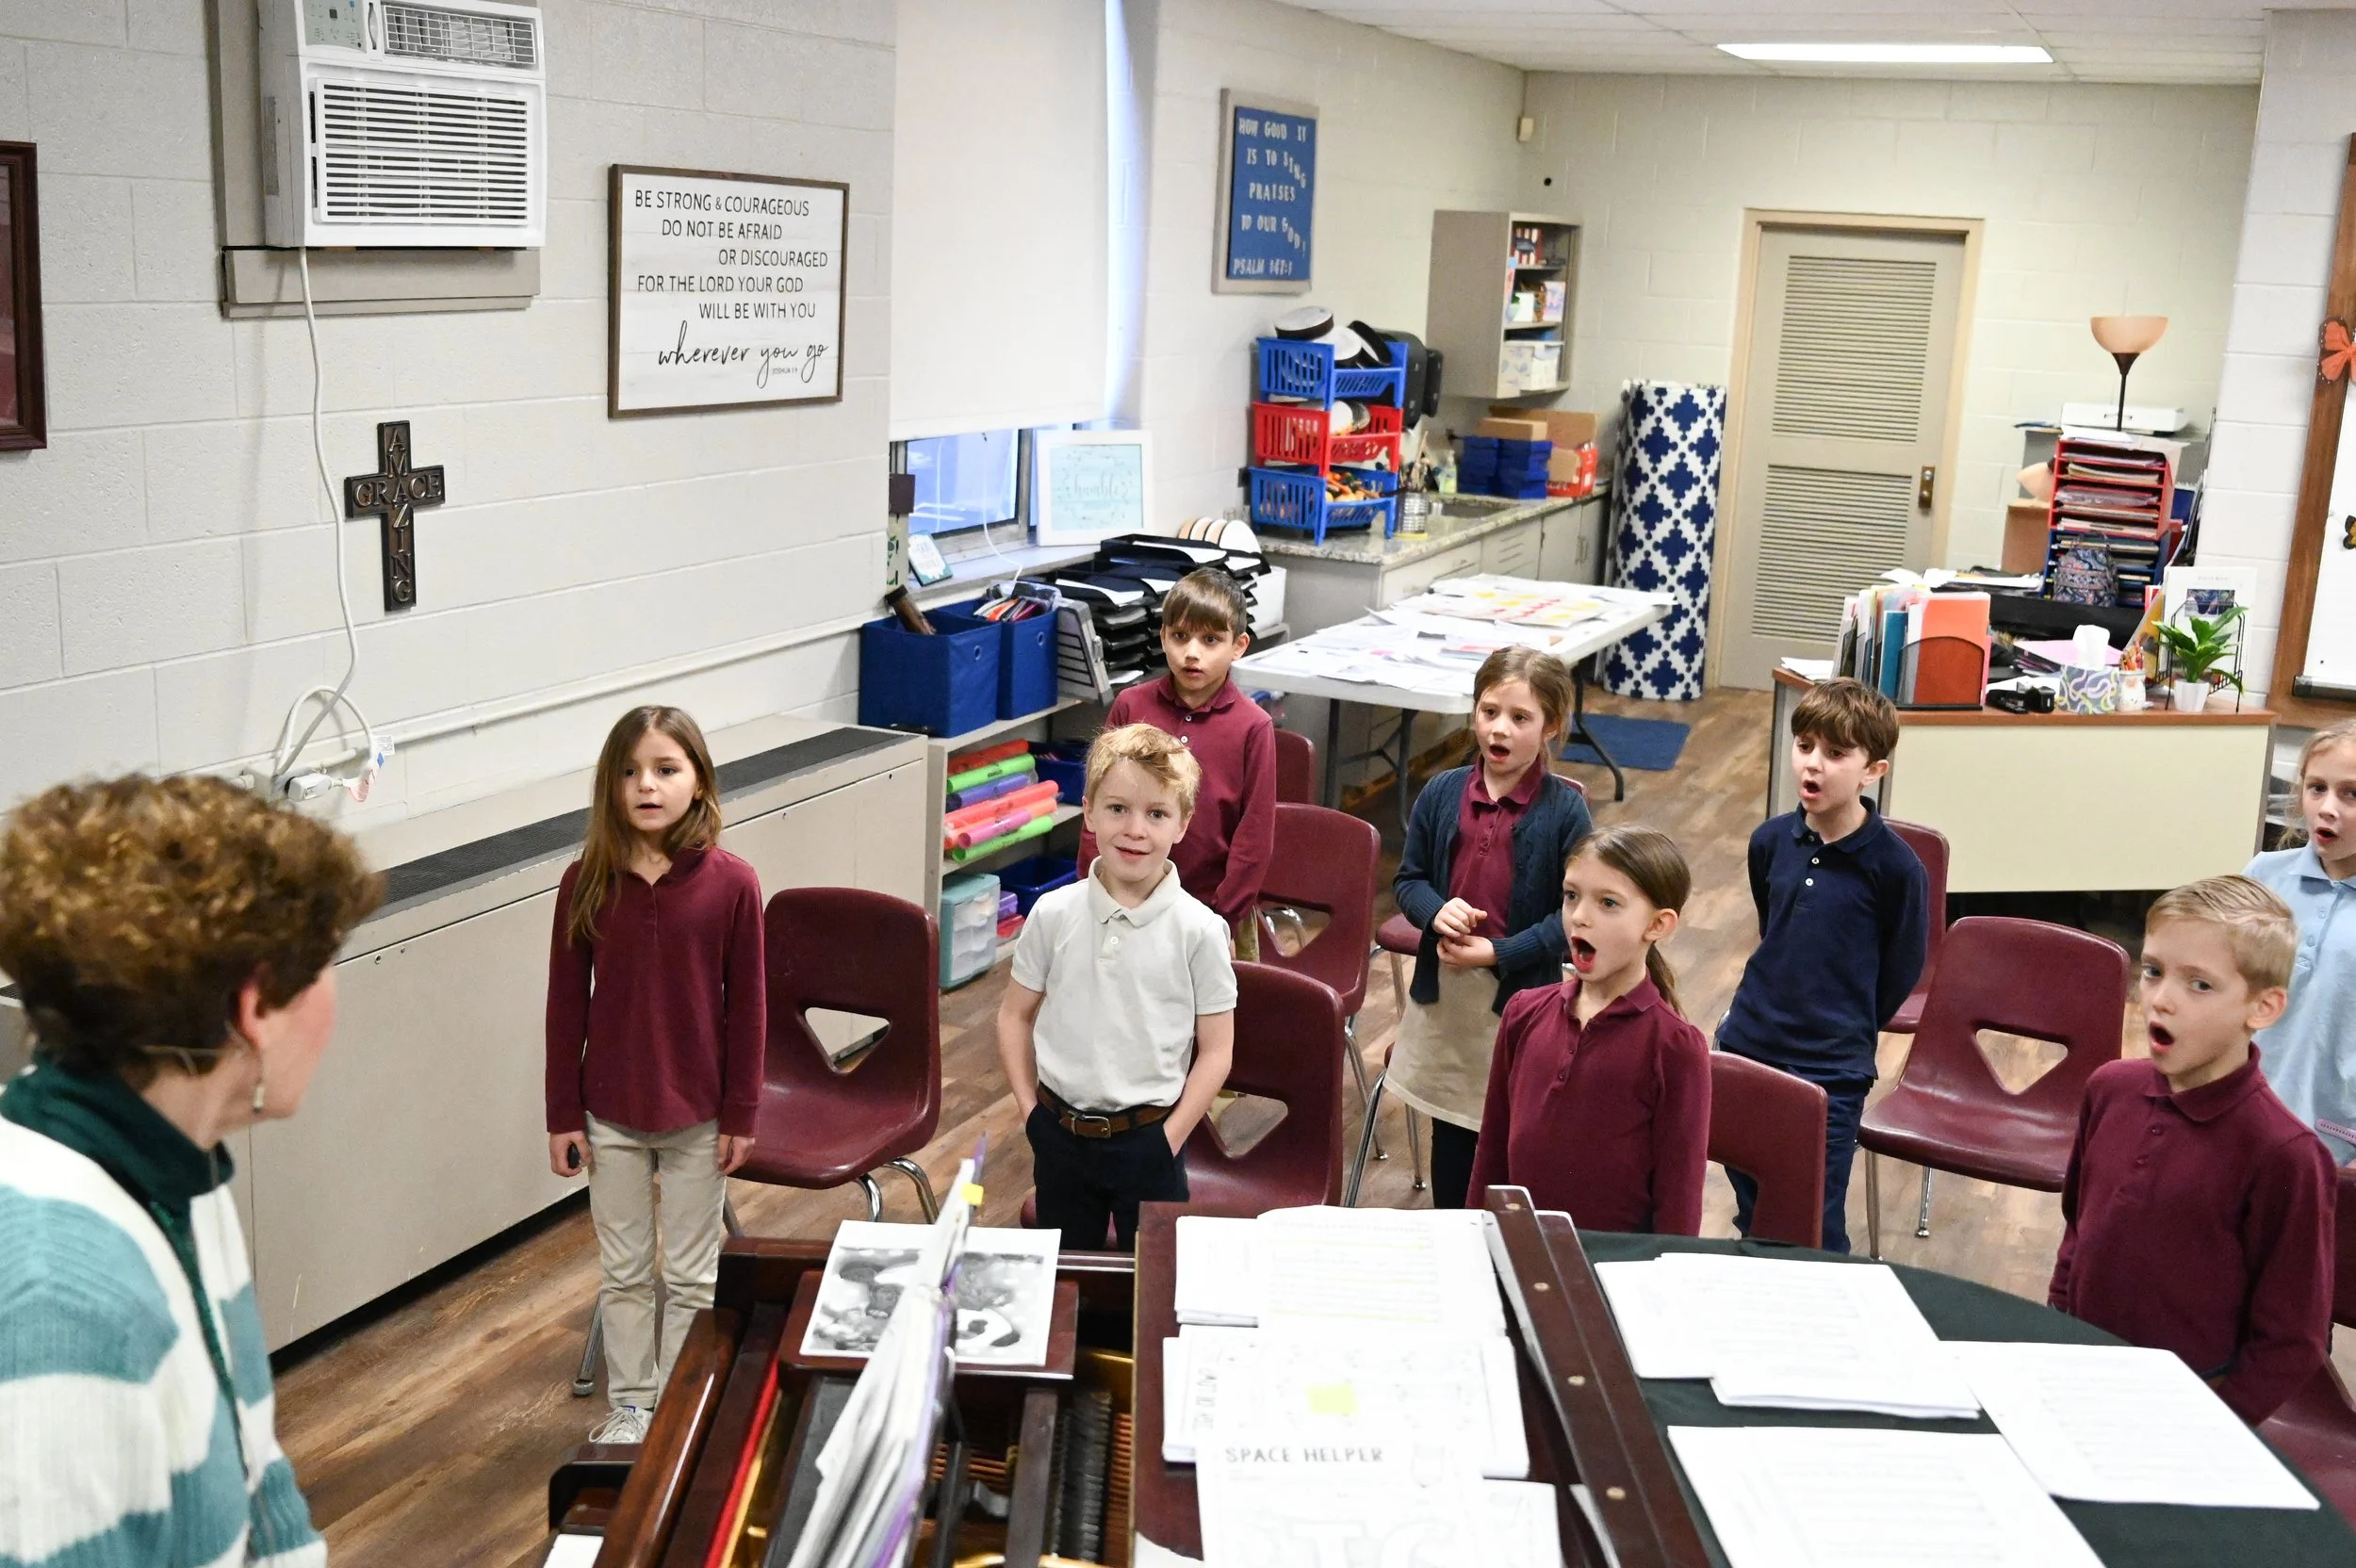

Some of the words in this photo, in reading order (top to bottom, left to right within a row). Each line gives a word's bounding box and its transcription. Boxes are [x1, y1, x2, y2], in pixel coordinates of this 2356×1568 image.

[1238, 118, 1258, 137] HOW
[1264, 121, 1287, 139] GOOD
[1298, 124, 1306, 142] IT
[1247, 148, 1257, 165] IS
[1265, 149, 1277, 166] TO
[1284, 151, 1306, 188] SING
[635, 189, 652, 208] BE
[657, 191, 712, 211] STRONG
[715, 197, 722, 211] &
[725, 195, 810, 216] COURAGEOUS
[1250, 182, 1295, 202] PRAISES
[662, 219, 682, 237] DO
[687, 220, 713, 237] NOT
[718, 222, 734, 238] BE
[738, 222, 782, 240] AFRAID
[1241, 214, 1252, 232] TO
[1257, 215, 1277, 233] OUR
[1282, 217, 1306, 258] GOD!
[718, 249, 736, 265] OR
[742, 250, 828, 268] DISCOURAGED
[1234, 257, 1265, 275] PSALM
[638, 275, 664, 292] FOR
[669, 275, 695, 292] THE
[699, 276, 734, 292] LORD
[738, 276, 772, 292] YOUR
[777, 277, 803, 293] GOD
[699, 302, 729, 318] WILL
[734, 302, 749, 318] BE
[754, 302, 786, 318] WITH
[791, 302, 816, 318] YOU
[658, 319, 750, 366] wherever
[757, 347, 798, 388] you
[801, 344, 829, 384] go
[353, 474, 441, 507] GRACE
[386, 429, 412, 602] AMAZING
[1225, 1446, 1290, 1462] SPACE
[1303, 1446, 1383, 1462] HELPER
